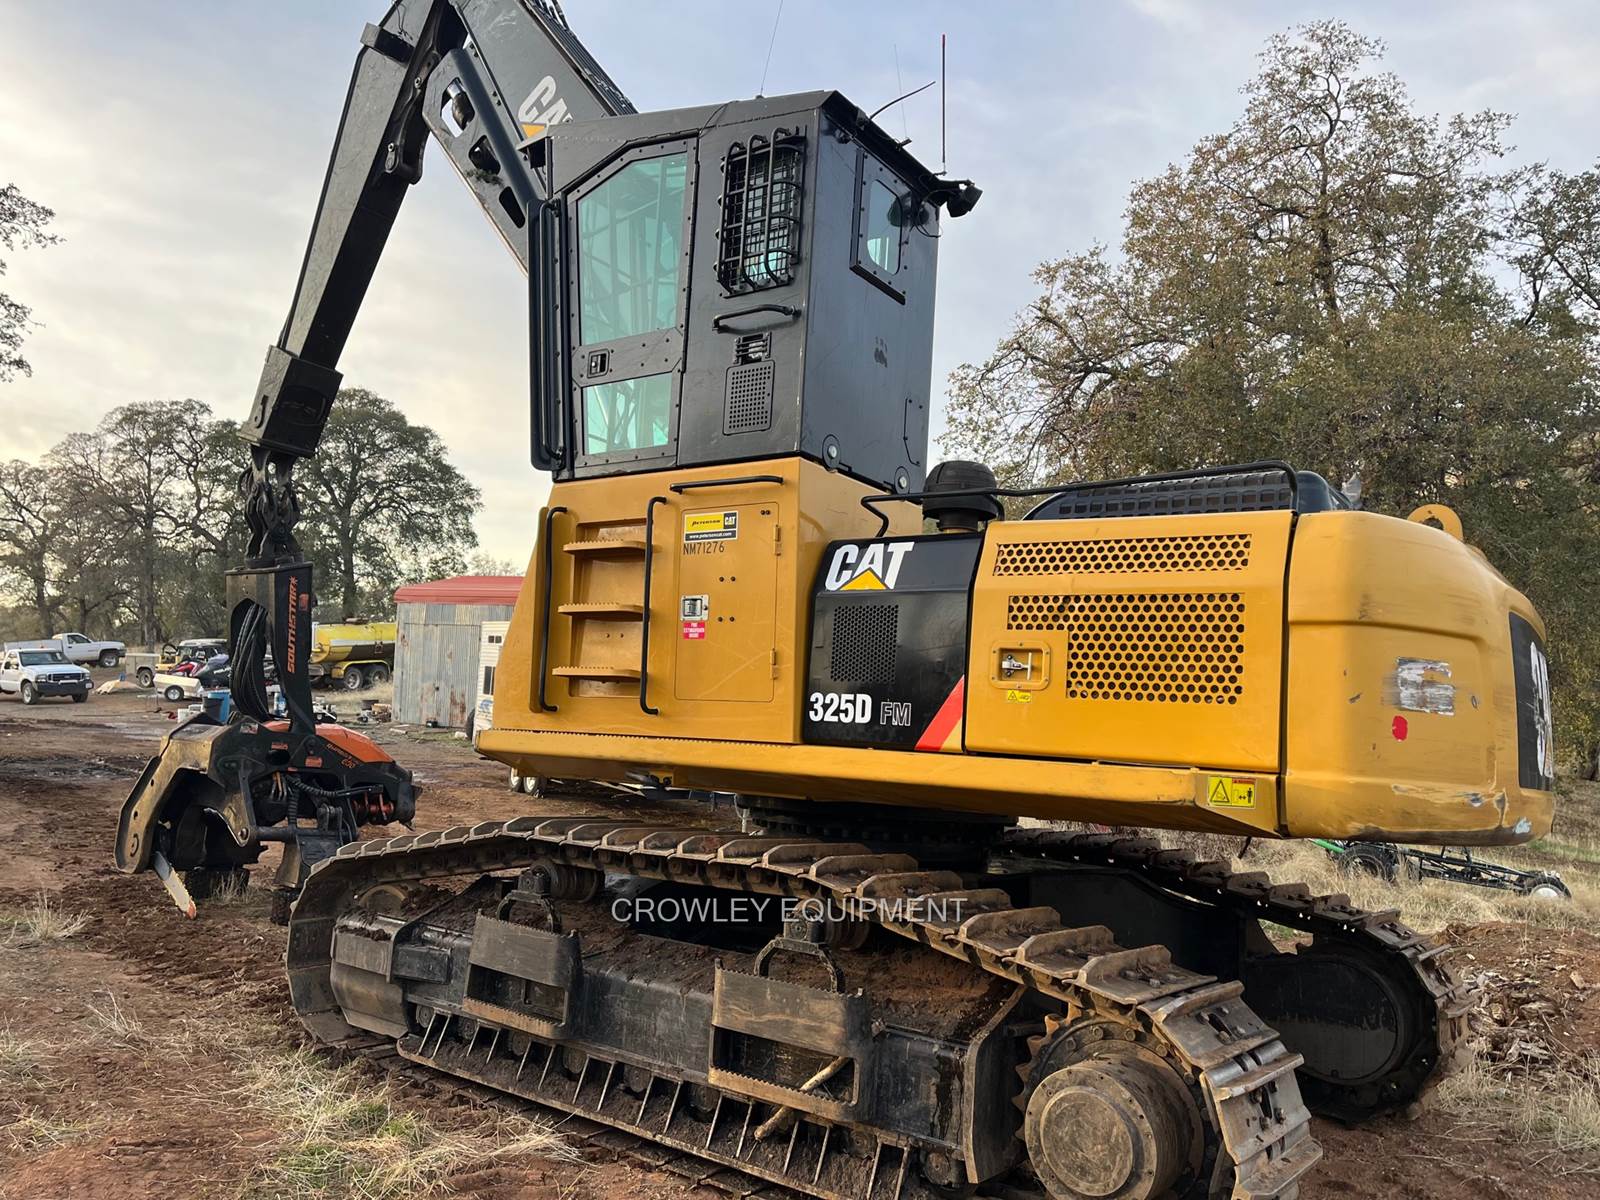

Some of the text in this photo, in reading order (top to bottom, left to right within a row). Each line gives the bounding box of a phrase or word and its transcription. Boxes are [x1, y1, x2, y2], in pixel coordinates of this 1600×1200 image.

[518, 75, 574, 125] CA
[683, 541, 725, 555] NM71276
[825, 541, 915, 591] CAT
[808, 691, 912, 726] 325D FM
